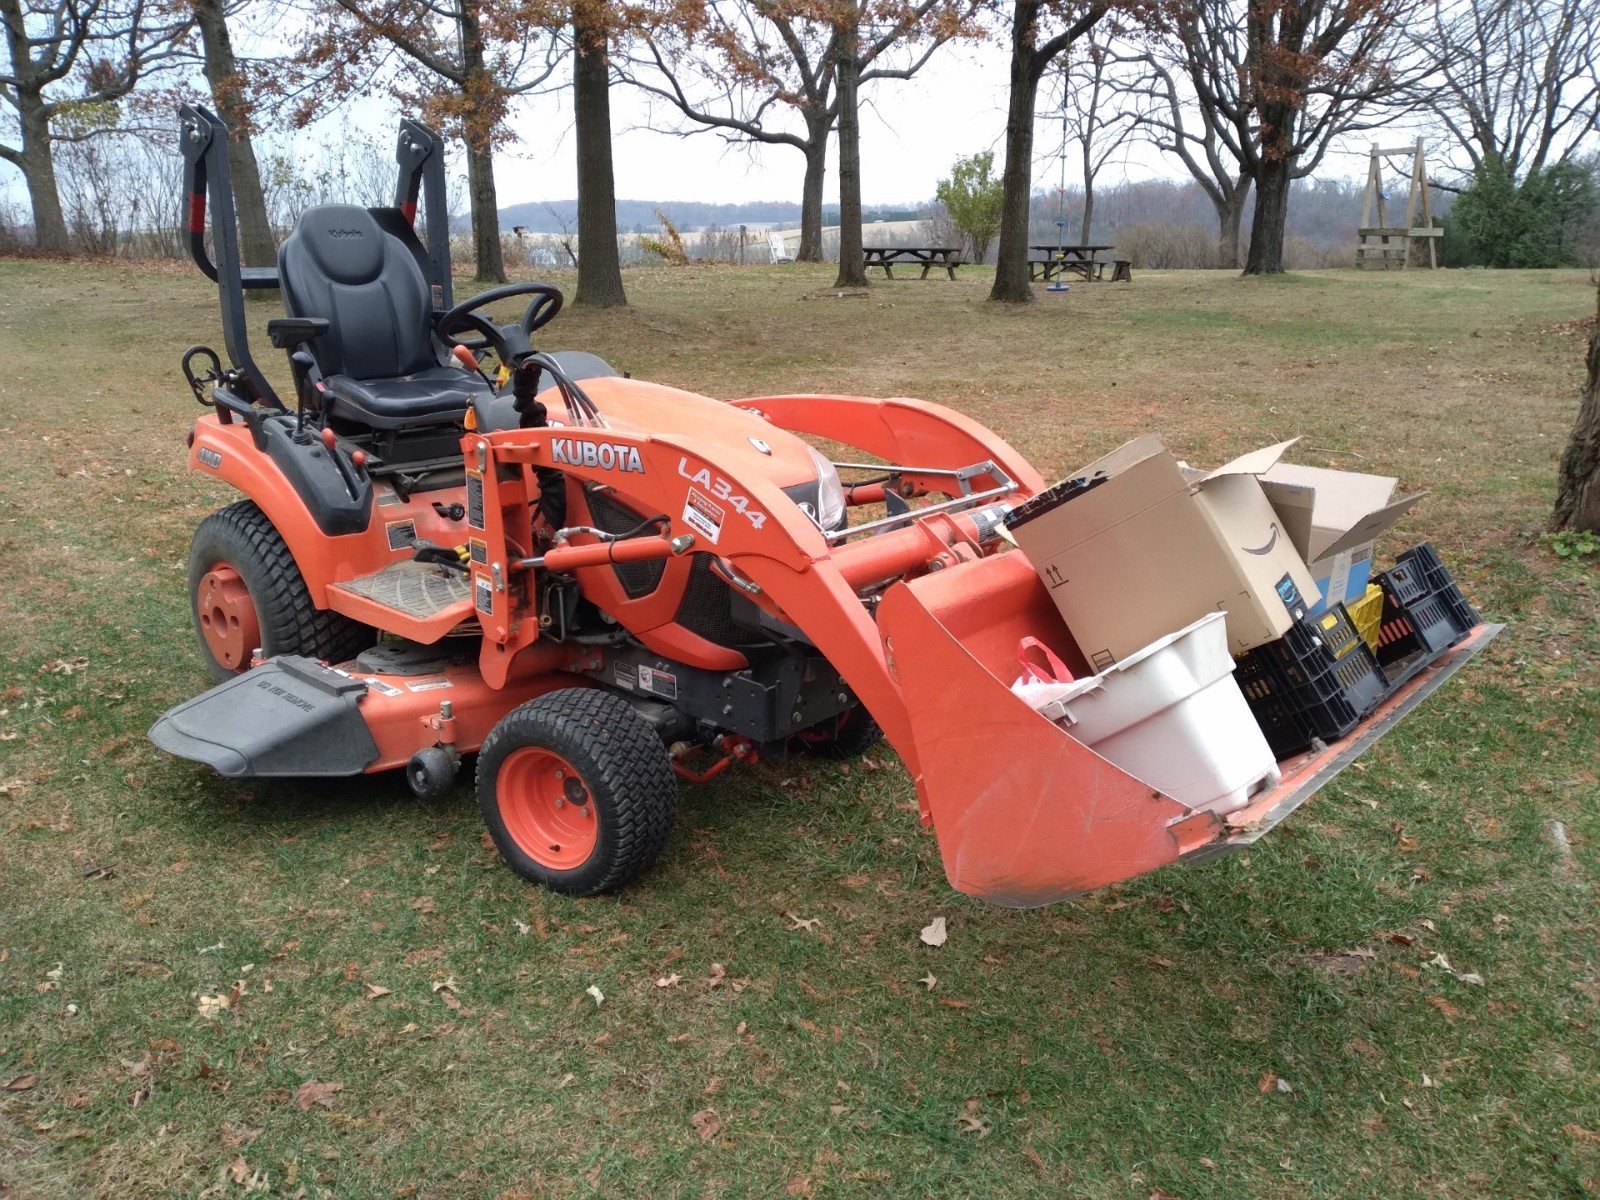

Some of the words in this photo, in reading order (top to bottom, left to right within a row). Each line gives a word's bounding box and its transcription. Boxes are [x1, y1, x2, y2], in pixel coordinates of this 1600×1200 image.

[198, 447, 222, 468] 4WD
[551, 437, 645, 474] KUBOTA
[678, 457, 767, 529] LA344
